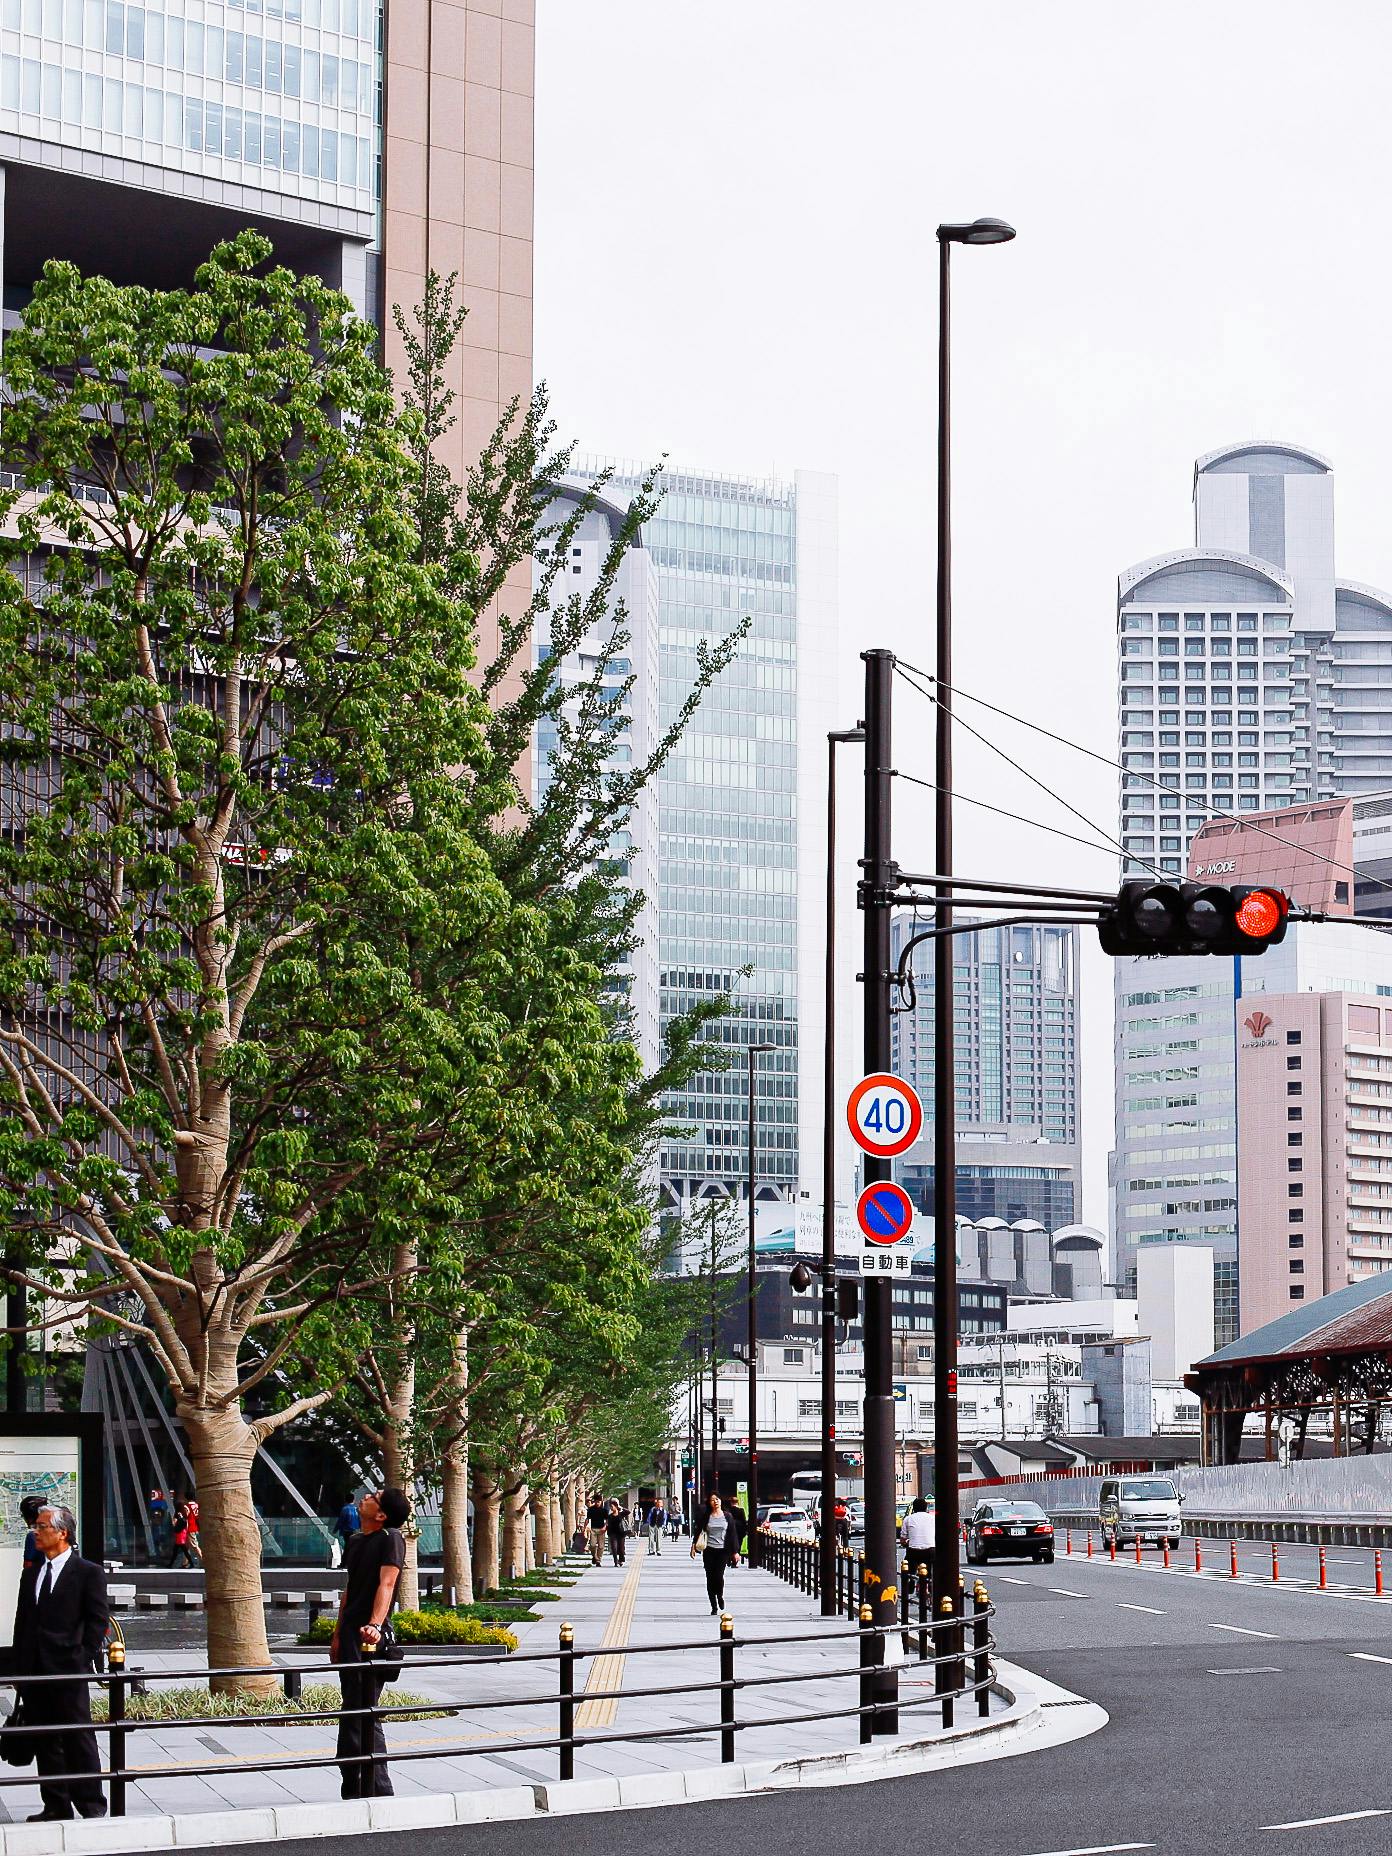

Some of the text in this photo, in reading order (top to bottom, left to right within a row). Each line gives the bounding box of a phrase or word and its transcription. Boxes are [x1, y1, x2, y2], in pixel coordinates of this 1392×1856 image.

[1206, 860, 1236, 875] MODE
[864, 1098, 905, 1133] 40
[862, 1255, 909, 1270] 自動車
